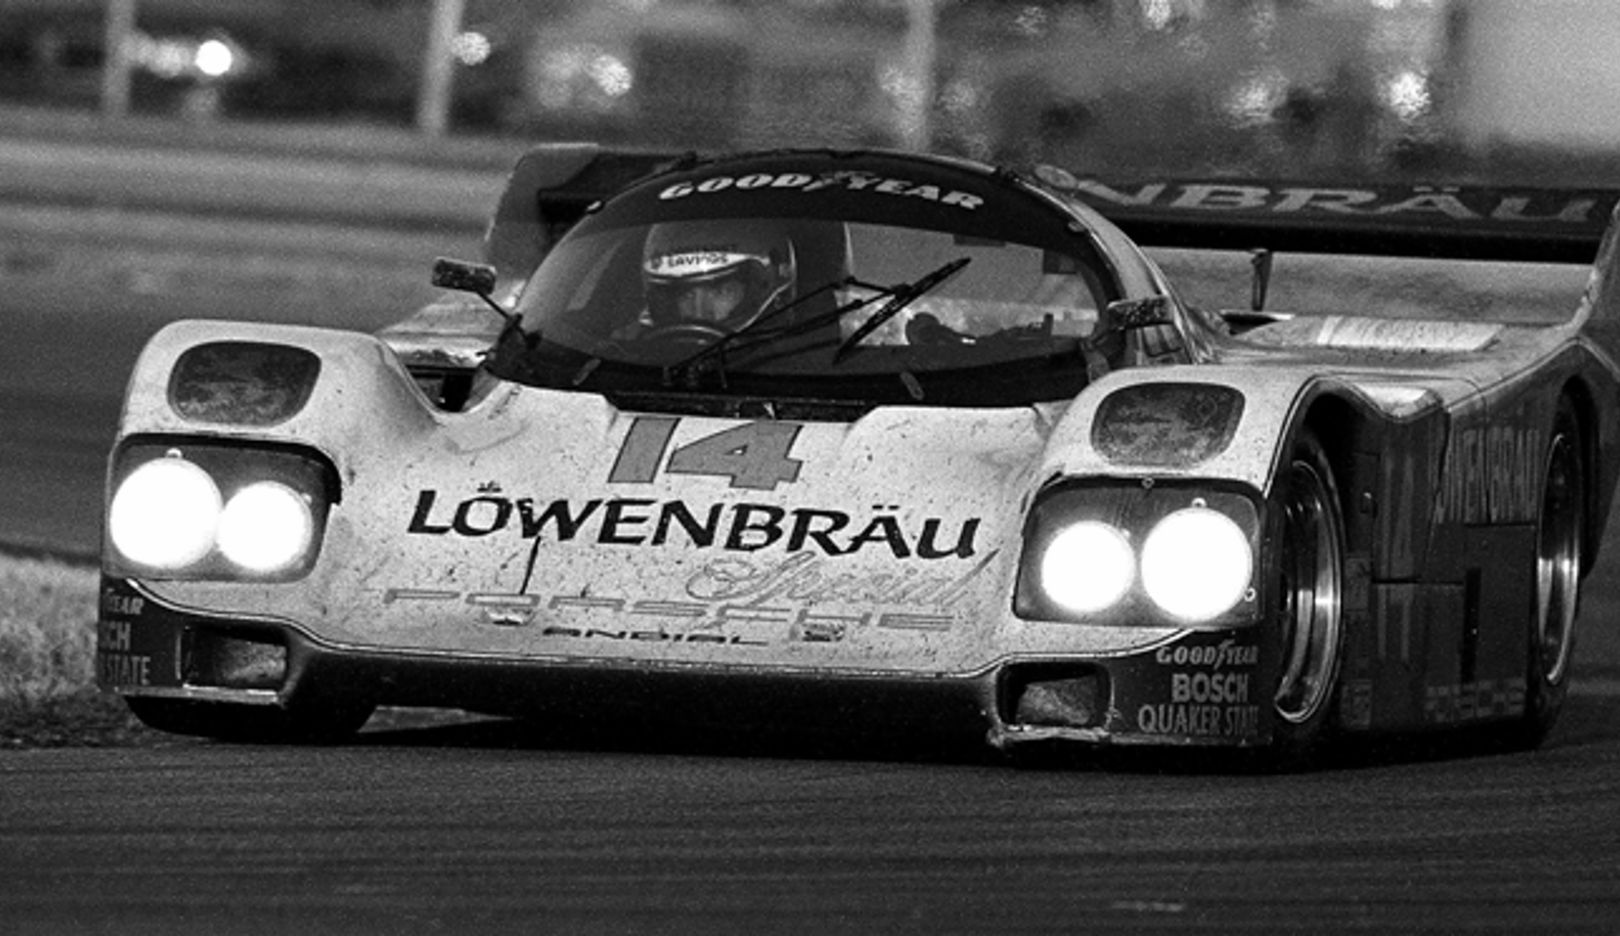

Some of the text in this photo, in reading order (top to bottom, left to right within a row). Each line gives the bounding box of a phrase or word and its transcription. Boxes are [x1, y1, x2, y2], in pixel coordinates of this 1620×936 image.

[659, 170, 984, 210] GOODYEAR
[608, 417, 803, 491] 14
[407, 486, 980, 559] LÖWENBRÄU
[383, 587, 955, 635] PORSCHE
[542, 627, 769, 645] ANDIAL
[1171, 672, 1249, 703] BOSCH
[1137, 703, 1221, 735] QUAKER
